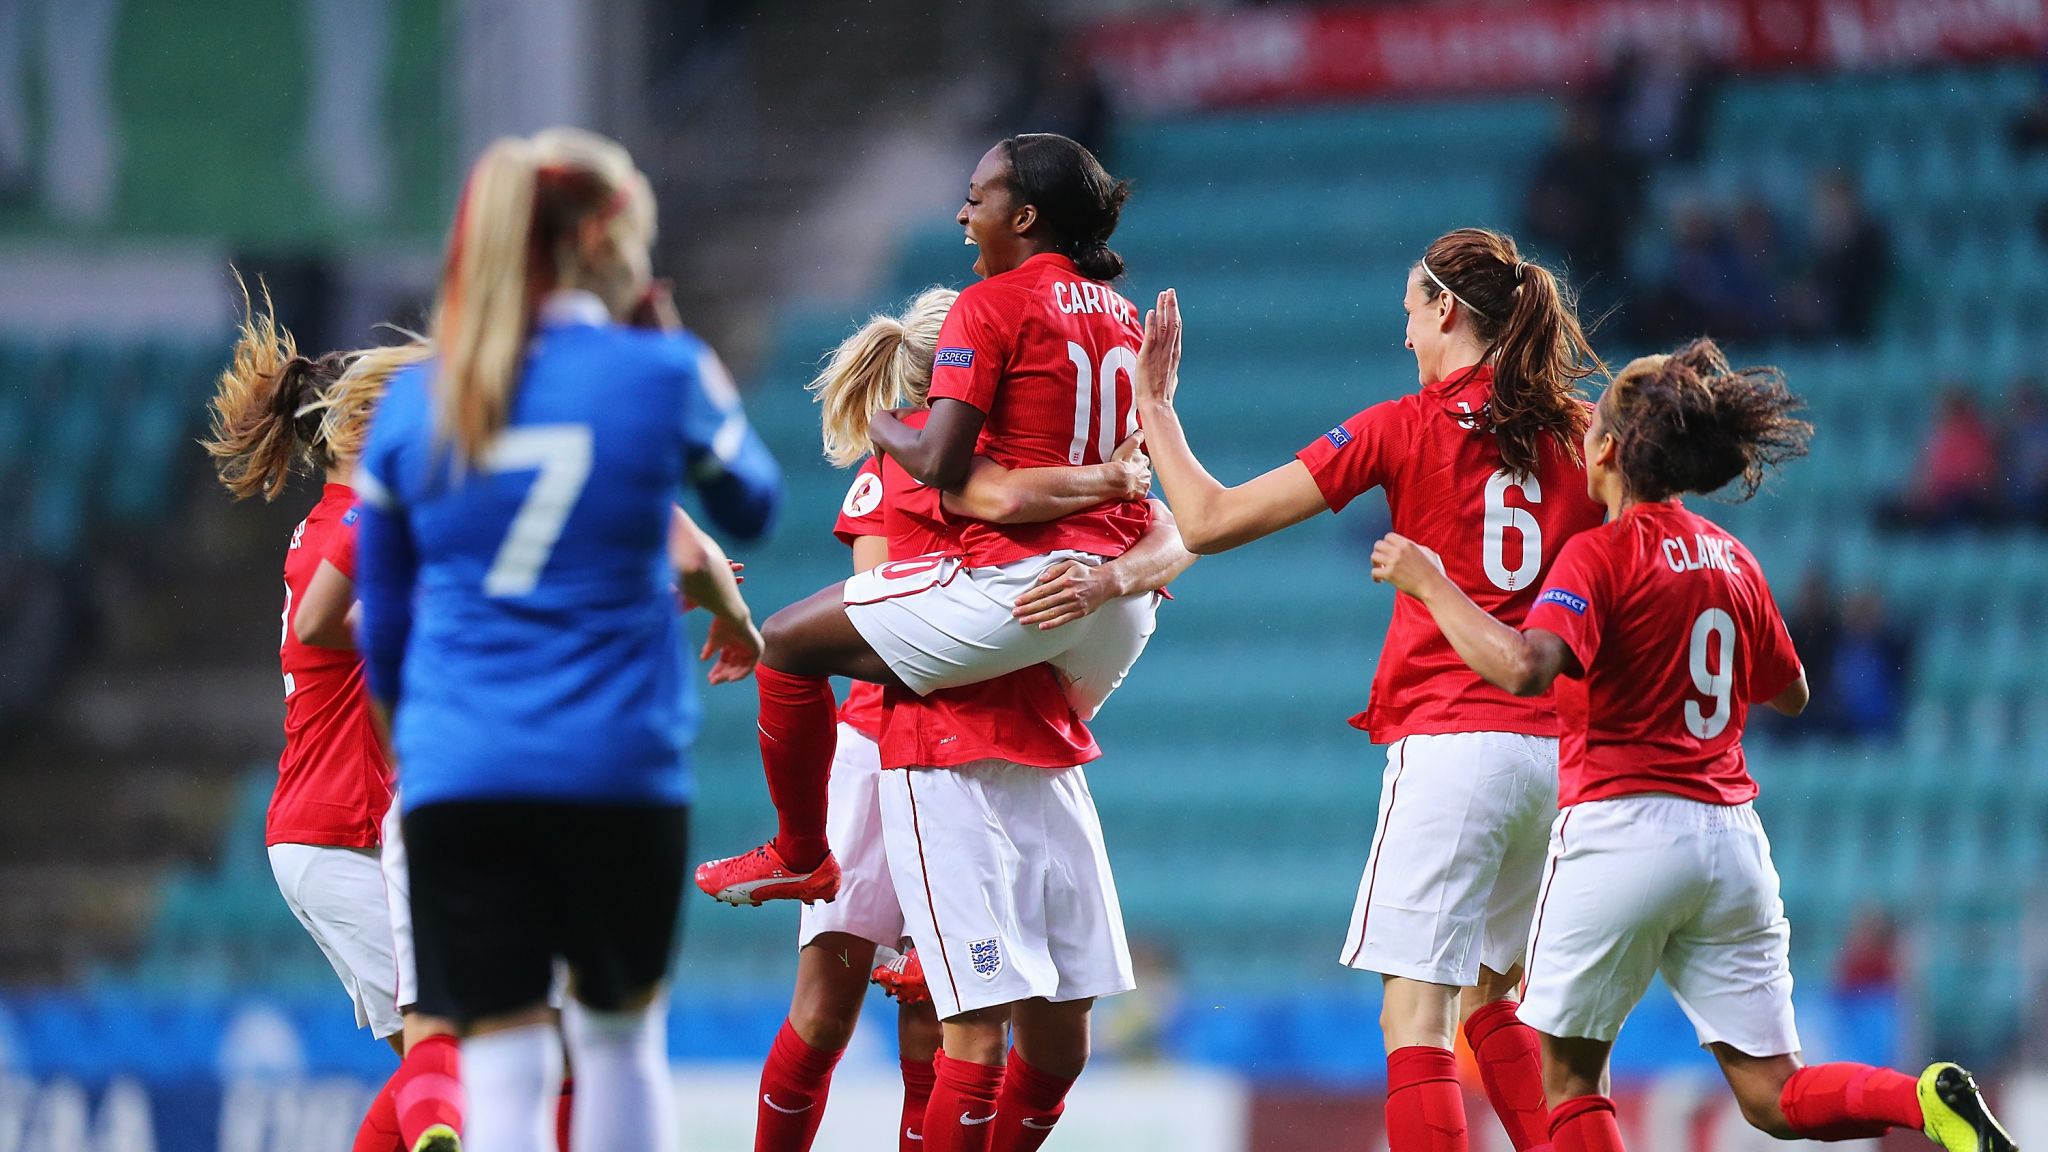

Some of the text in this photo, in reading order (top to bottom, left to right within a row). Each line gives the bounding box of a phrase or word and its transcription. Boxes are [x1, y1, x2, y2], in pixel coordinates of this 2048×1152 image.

[1067, 340, 1139, 465] 10
[482, 421, 593, 597] 7
[1483, 467, 1542, 592] 6
[1662, 533, 1740, 573] CLARKE
[1684, 607, 1736, 740] 9
